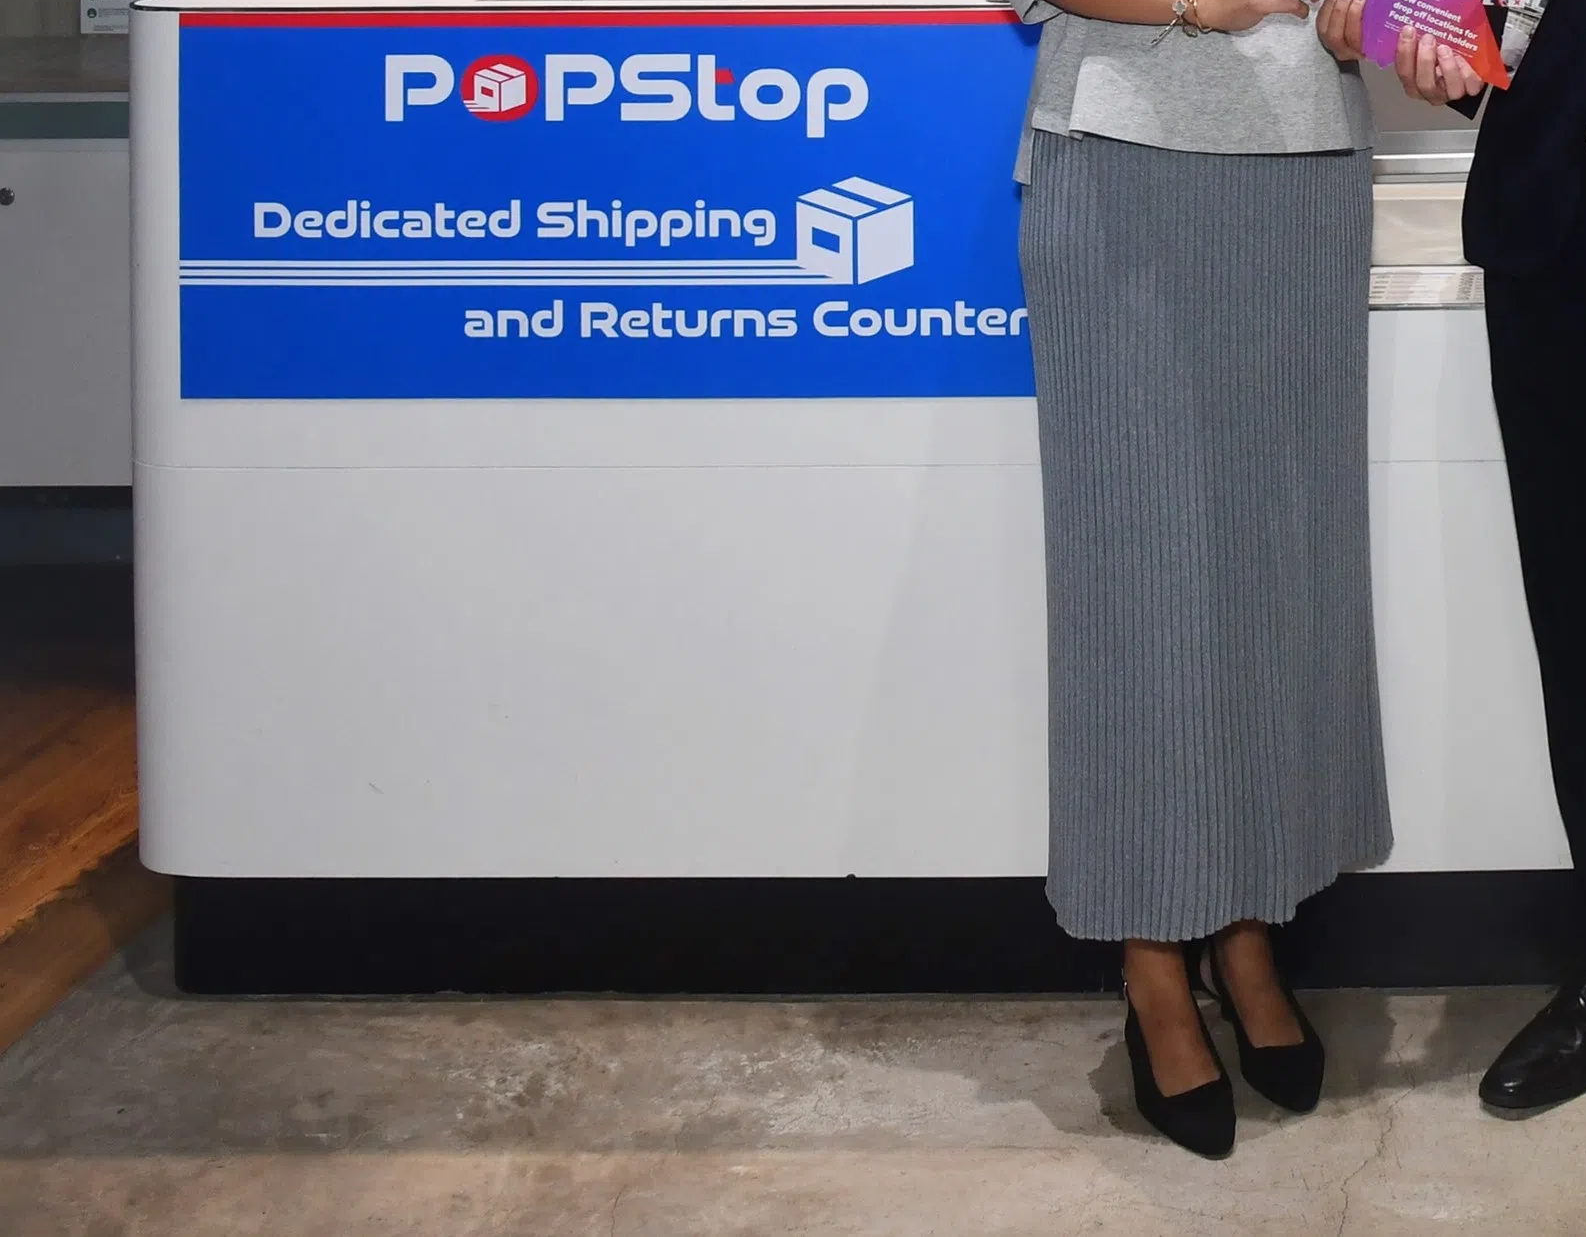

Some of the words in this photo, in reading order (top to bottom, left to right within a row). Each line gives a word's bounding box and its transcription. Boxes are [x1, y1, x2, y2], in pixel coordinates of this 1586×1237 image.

[1388, 10, 1415, 27] FedEx
[1414, 22, 1447, 40] account
[1447, 32, 1478, 52] holders
[1393, 2, 1413, 15] drop
[1413, 10, 1428, 21] off
[1426, 14, 1464, 36] locations
[1464, 29, 1478, 40] for
[1417, 0, 1461, 23] convenient
[253, 199, 521, 239] Dedicated
[536, 199, 776, 247] Shipping
[464, 299, 564, 338] and
[580, 302, 798, 338] Returns
[813, 300, 1029, 338] Counter
